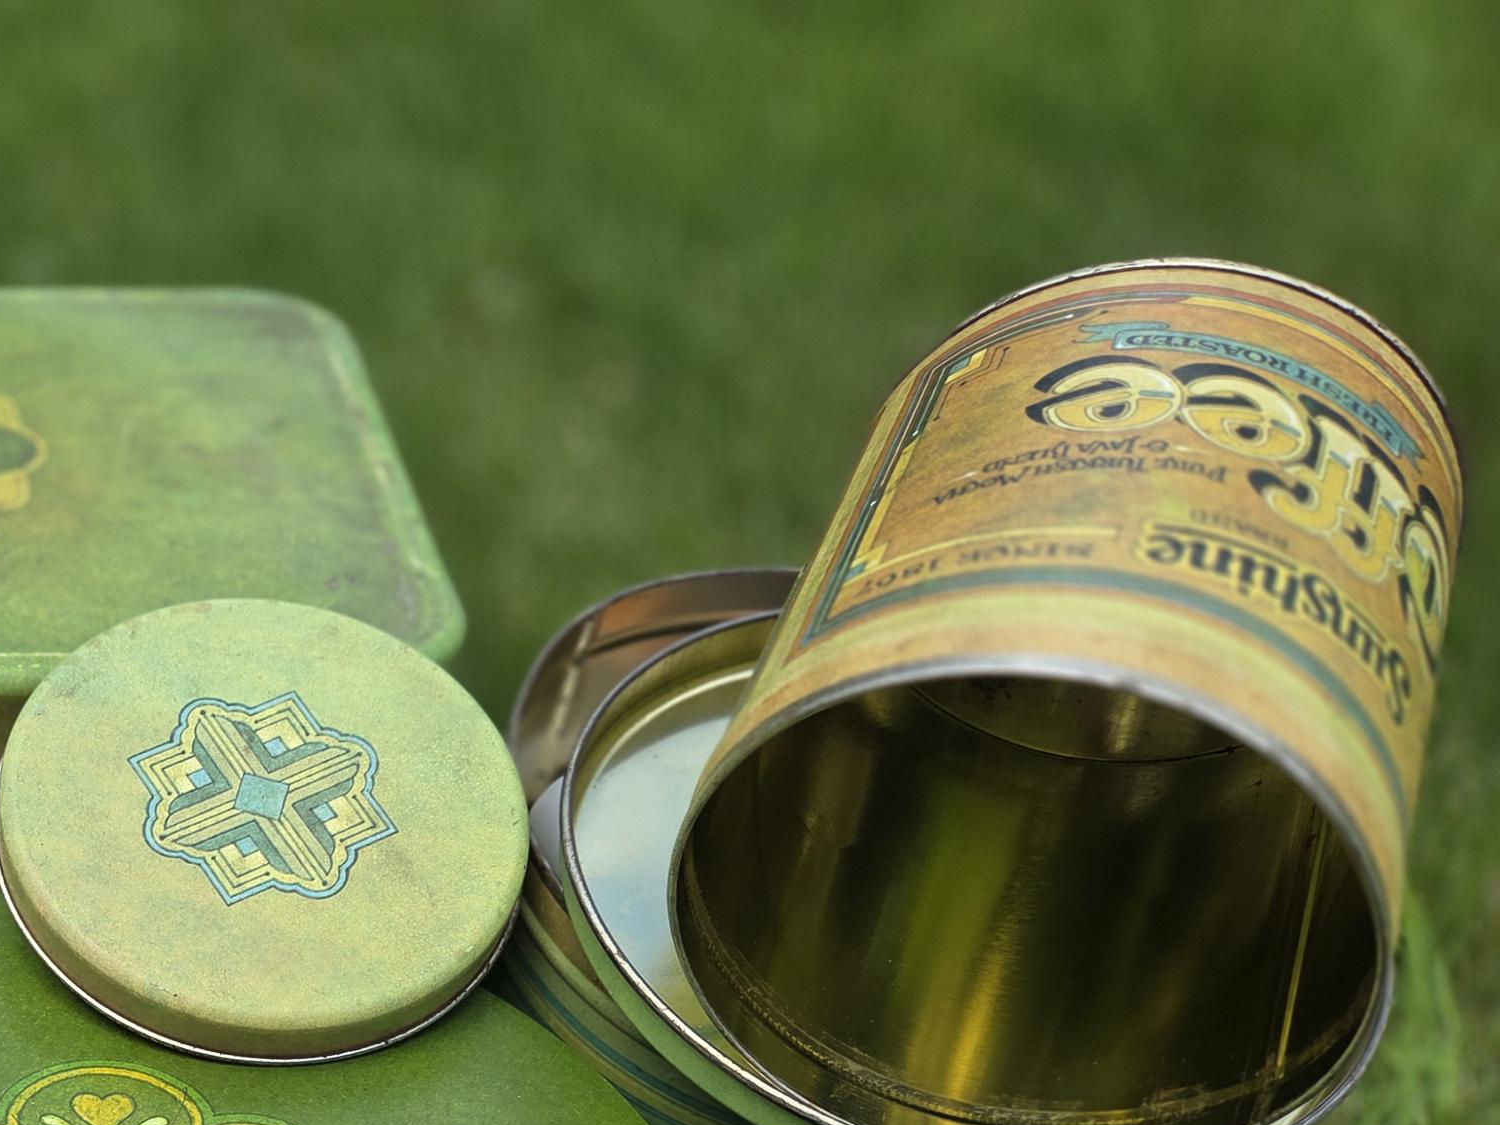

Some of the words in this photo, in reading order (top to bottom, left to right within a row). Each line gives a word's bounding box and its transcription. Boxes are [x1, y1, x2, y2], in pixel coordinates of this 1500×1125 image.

[1127, 334, 1290, 373] ROASTED
[1296, 360, 1393, 442] FRESH
[982, 442, 1069, 473] BLEND
[1076, 435, 1142, 450] JAVA
[1032, 456, 1147, 477] TURKISH
[1152, 457, 1227, 483] PURE
[933, 464, 1030, 505] MOCHA
[1146, 536, 1411, 725] Sunshine
